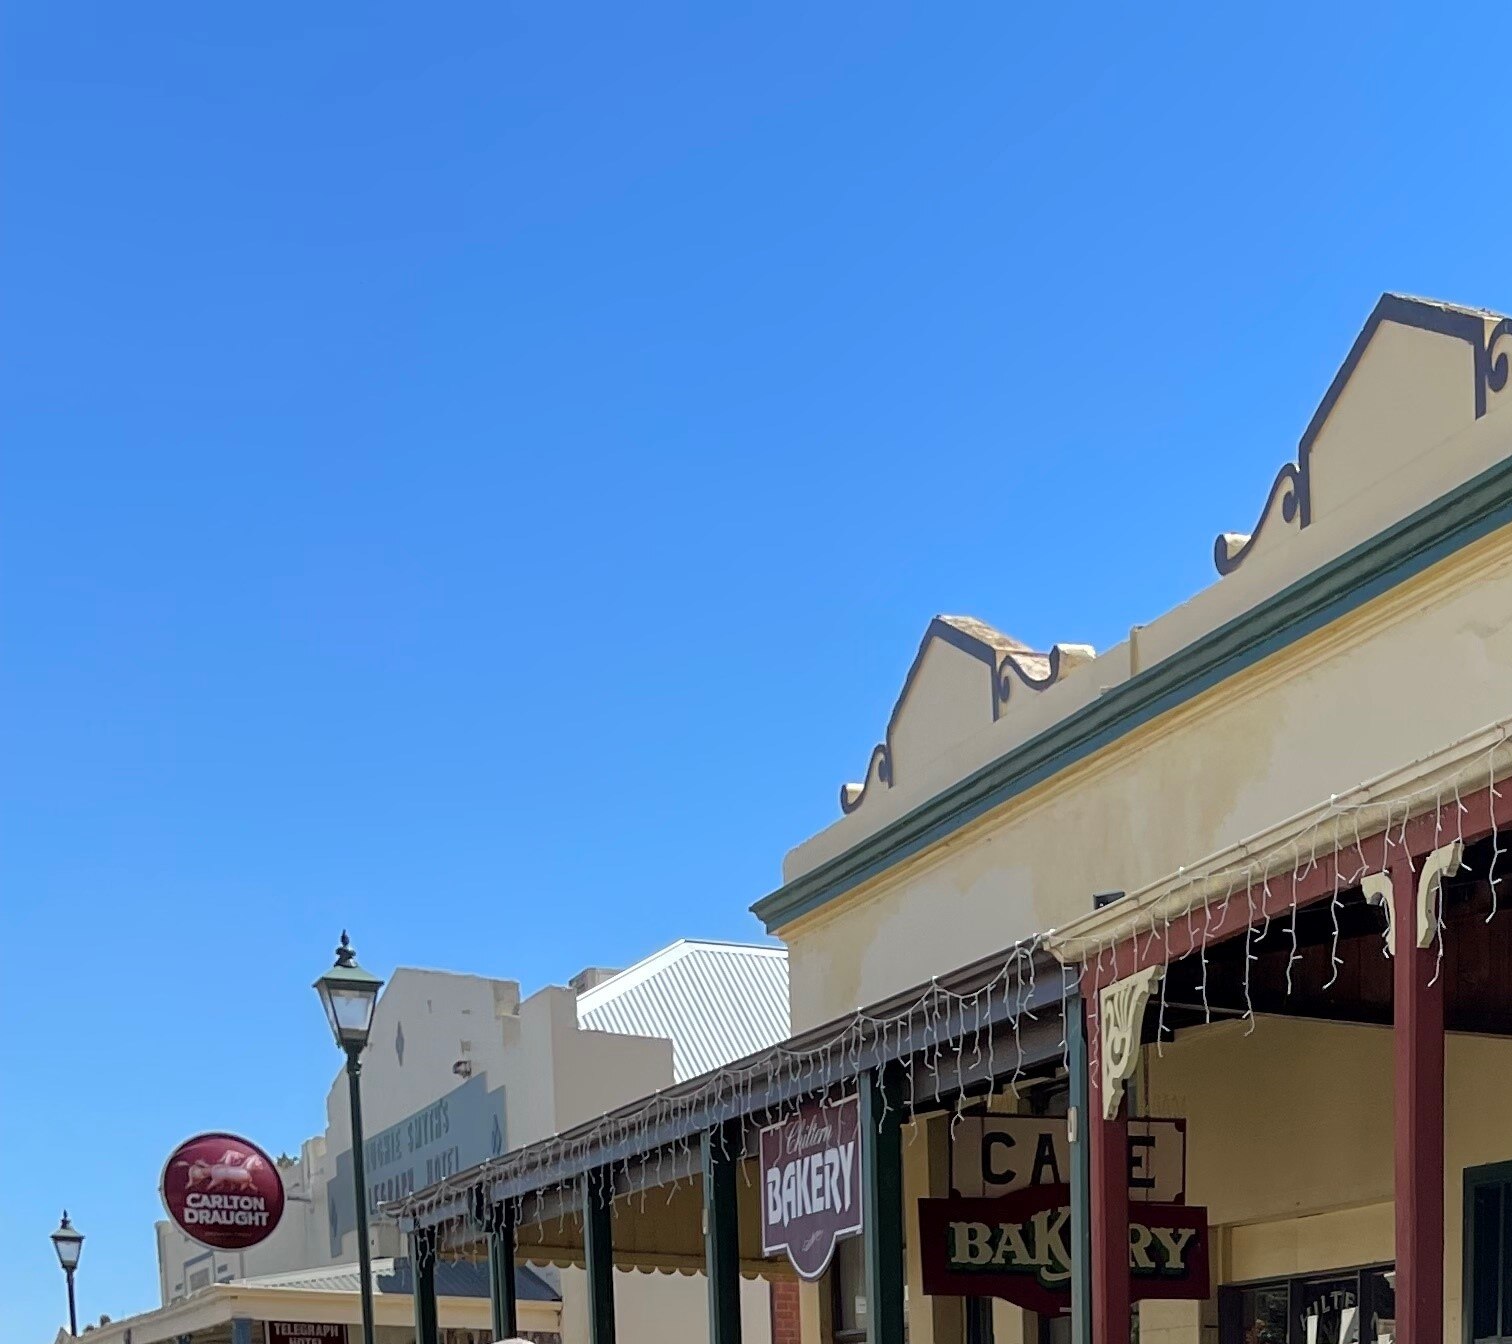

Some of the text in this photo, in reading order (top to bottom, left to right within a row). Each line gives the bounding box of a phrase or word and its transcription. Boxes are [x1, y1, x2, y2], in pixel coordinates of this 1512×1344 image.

[981, 1131, 1156, 1188] CAE
[186, 1192, 265, 1210] CARLTON
[766, 1141, 854, 1227] BAKERY
[183, 1208, 270, 1226] DRAUGHT
[949, 1206, 1196, 1282] BAKRY
[274, 1322, 339, 1337] TELEGRAPH
